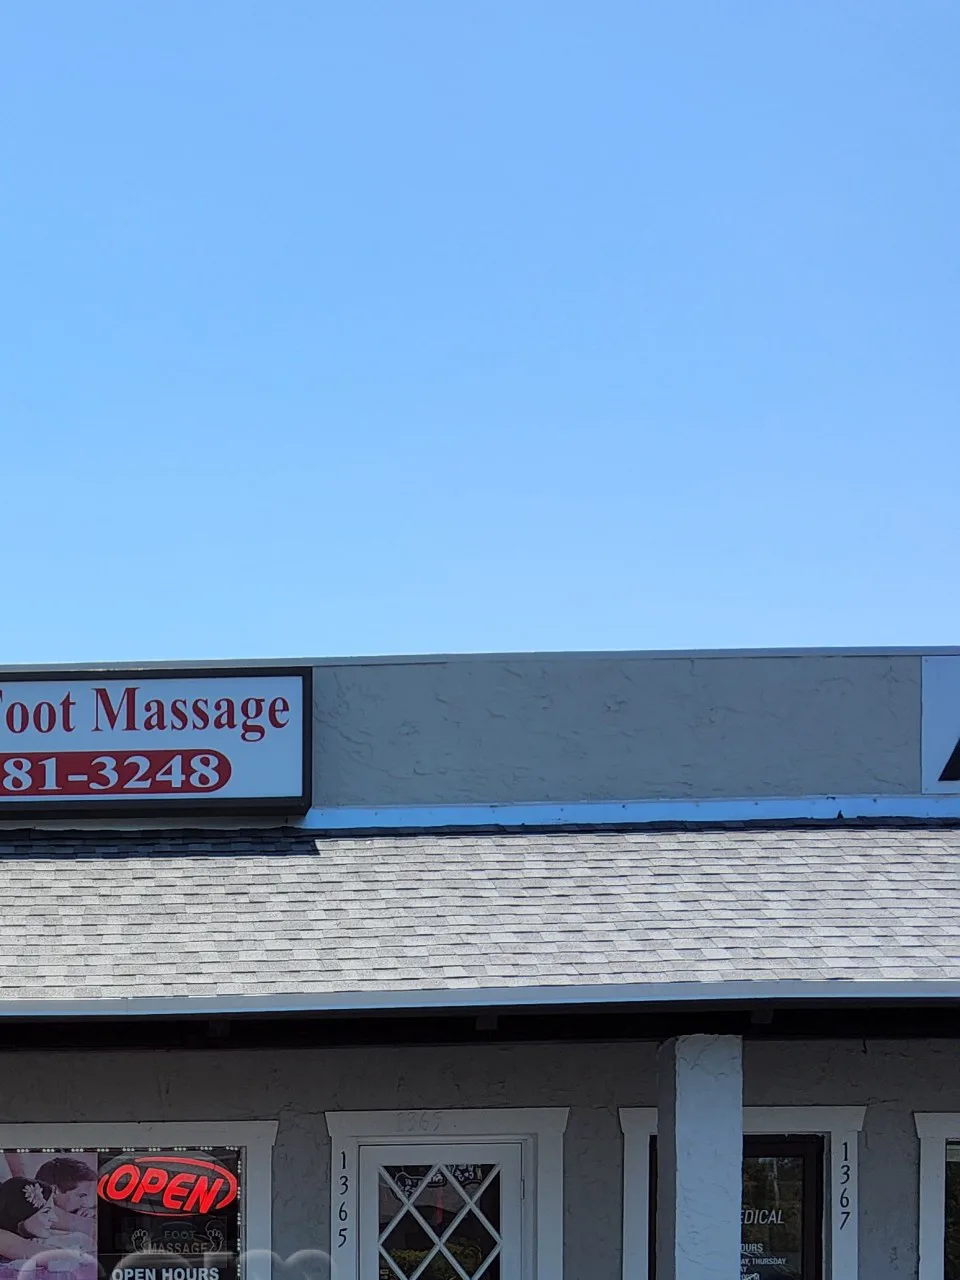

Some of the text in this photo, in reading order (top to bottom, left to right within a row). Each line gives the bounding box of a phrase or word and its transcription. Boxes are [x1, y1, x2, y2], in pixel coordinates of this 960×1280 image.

[91, 686, 290, 742] Massage
[106, 1163, 225, 1214] OPEN
[338, 1150, 349, 1248] 1365
[839, 1141, 851, 1231] 1367
[740, 1209, 785, 1225] EDICAL
[740, 1243, 764, 1252] OURS
[752, 1257, 786, 1265] THURSDAY
